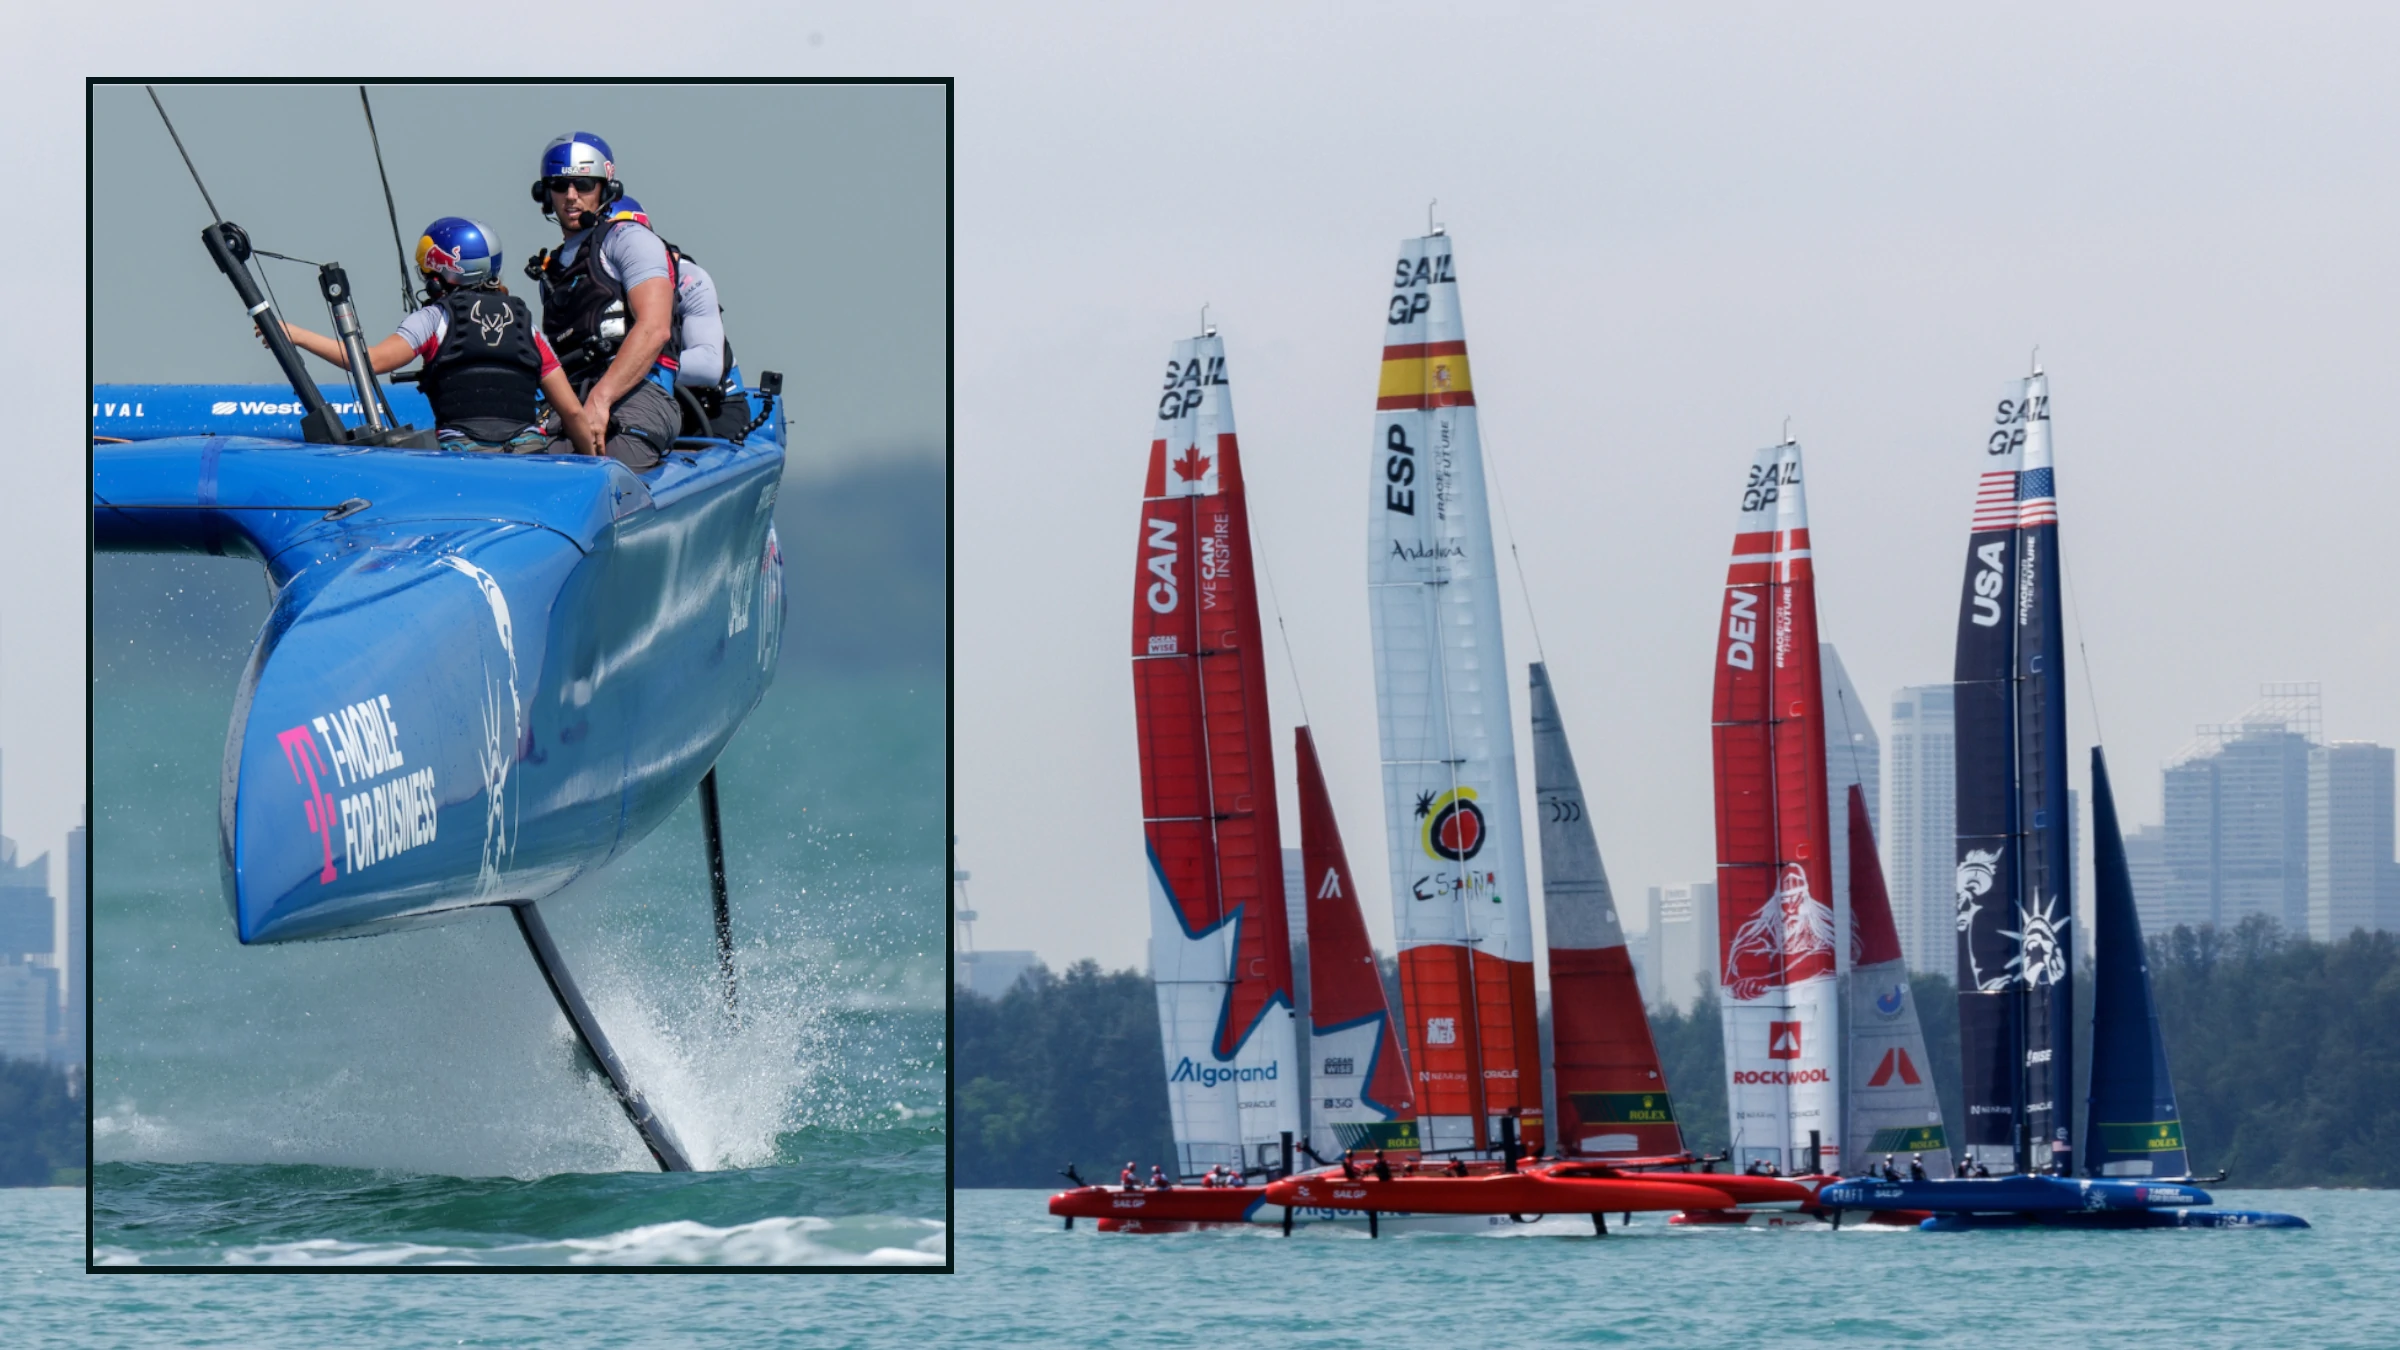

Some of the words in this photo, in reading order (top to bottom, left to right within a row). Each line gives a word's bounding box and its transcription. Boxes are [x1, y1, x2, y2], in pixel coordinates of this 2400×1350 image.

[561, 166, 579, 175] USA
[1394, 254, 1457, 288] SAIL
[1388, 292, 1431, 325] GP
[1163, 356, 1229, 391] SAIL
[240, 401, 302, 415] West
[1158, 388, 1204, 421] GP
[1994, 395, 2050, 425] SAIL
[1988, 428, 2027, 456] GP
[1386, 423, 1415, 516] ESP
[1746, 461, 1801, 488] SAIL
[1741, 487, 1779, 512] GP
[1214, 513, 1231, 578] INSPIRE
[1147, 518, 1178, 614] CAN
[1972, 540, 2006, 627] USA
[1726, 589, 1759, 671] DEN
[1151, 643, 1176, 652] WISE
[312, 694, 404, 788] T-MOBILE
[340, 791, 376, 874] FOR
[372, 765, 438, 862] BUSINESS
[1426, 1029, 1456, 1045] MED
[1170, 1056, 1278, 1089] Algorand
[1326, 1064, 1352, 1074] WISE
[1483, 1069, 1519, 1079] ORACLE
[1733, 1068, 1830, 1086] ROCKWOOL
[1239, 1100, 1277, 1110] ORACLE
[1629, 1110, 1666, 1120] ROLEX
[1910, 1140, 1941, 1150] ROLEX
[2148, 1138, 2178, 1148] ROLEX
